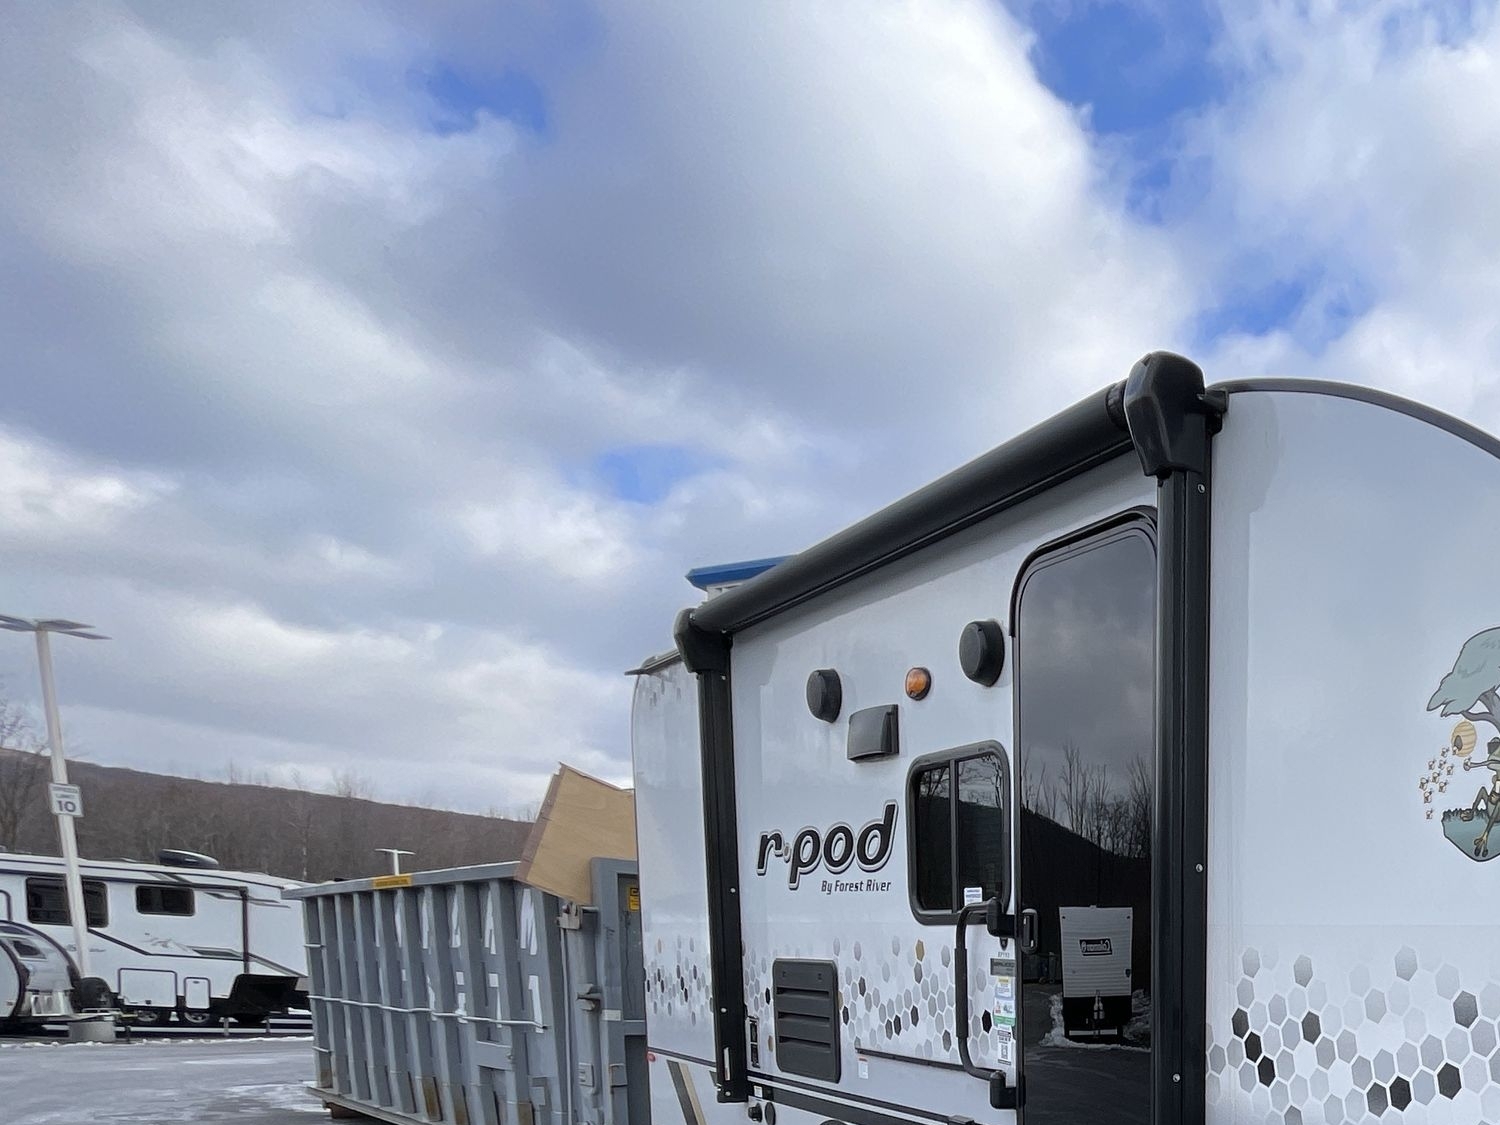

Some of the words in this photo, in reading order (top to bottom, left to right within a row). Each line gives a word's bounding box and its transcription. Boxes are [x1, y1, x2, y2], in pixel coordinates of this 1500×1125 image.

[58, 800, 76, 812] 10
[821, 880, 832, 894] By
[834, 879, 863, 892] Forest
[865, 879, 891, 892] River
